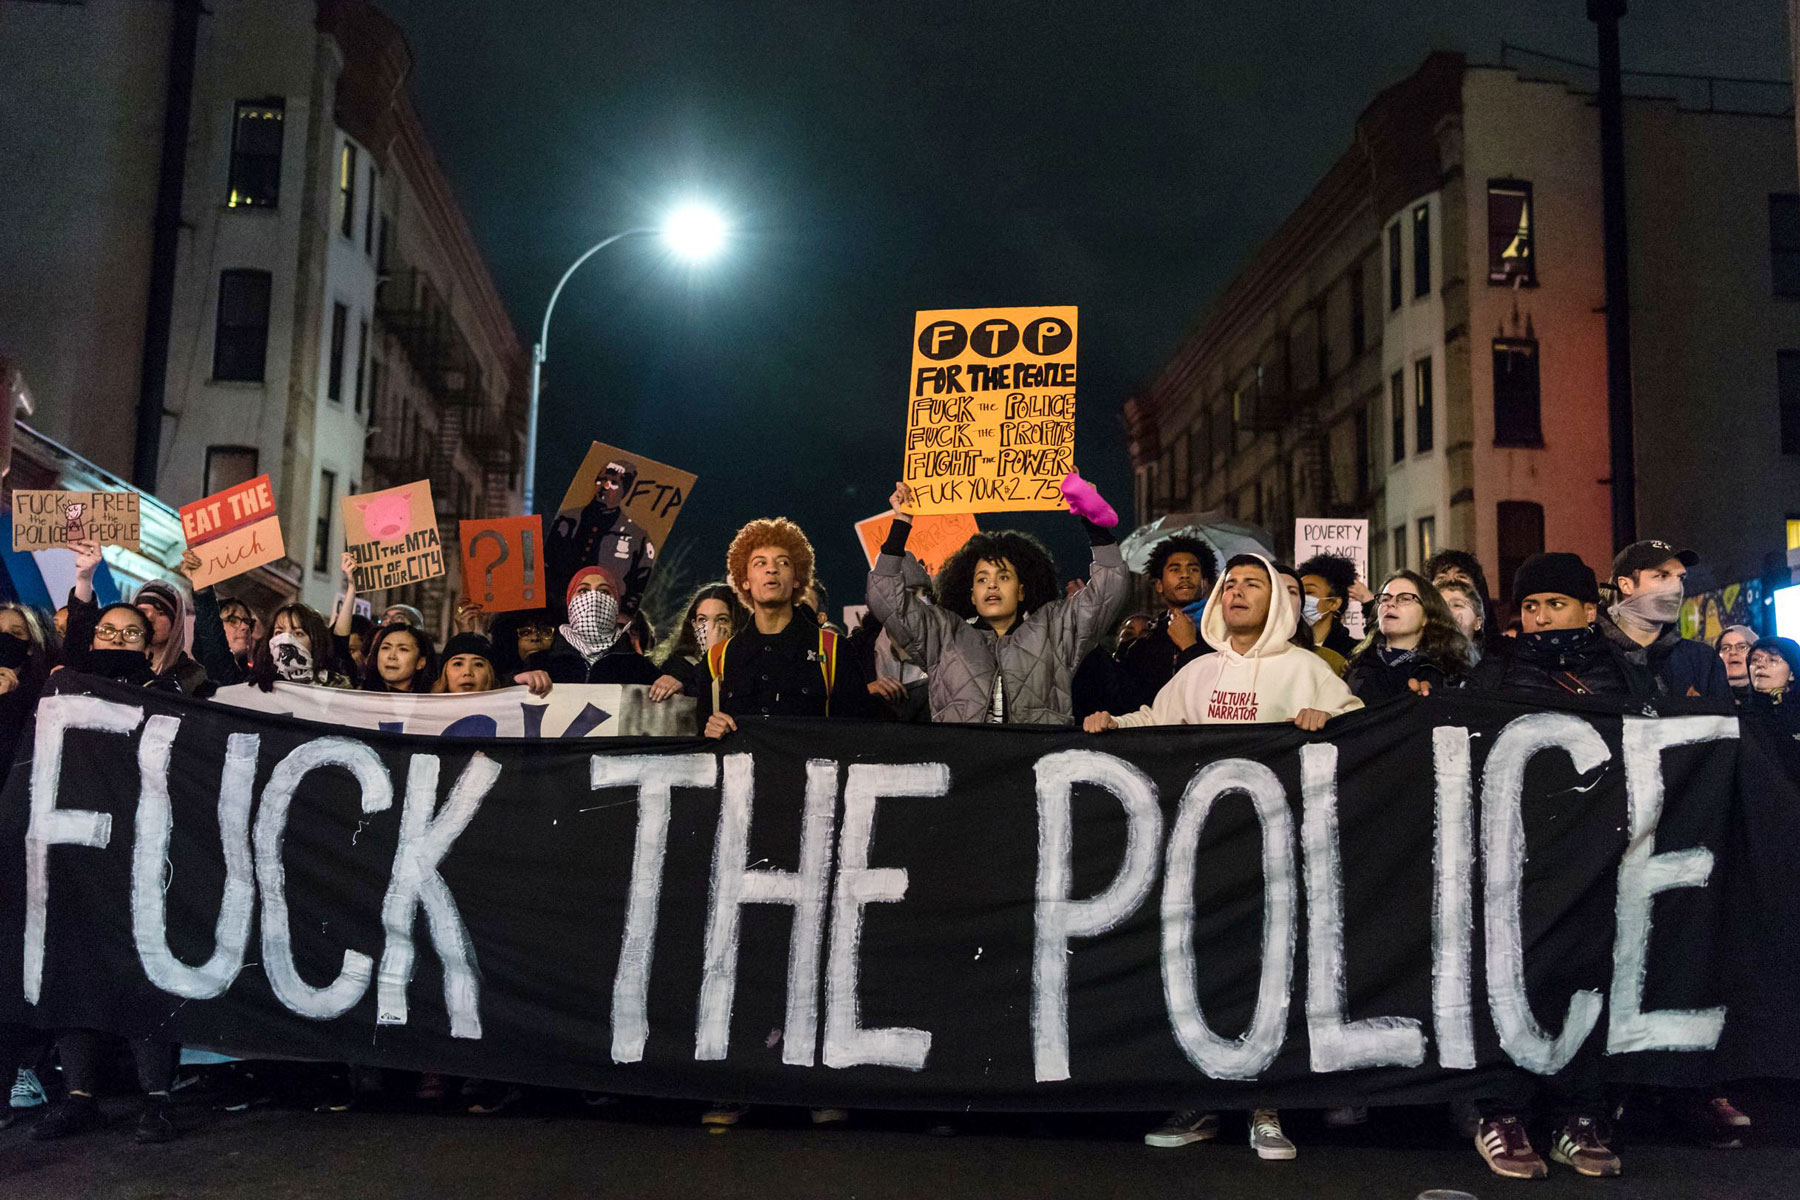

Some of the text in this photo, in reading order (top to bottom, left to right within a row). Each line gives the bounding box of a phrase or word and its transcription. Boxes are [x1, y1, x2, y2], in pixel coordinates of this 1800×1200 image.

[916, 362, 1076, 396] FOR THE PEOPLE
[911, 396, 975, 427] FUCK
[1005, 393, 1076, 420] POLICE
[908, 424, 974, 450] FUCK
[1000, 420, 1075, 447] PROFITS
[907, 449, 983, 480] FIGHT
[997, 446, 1072, 477] POWER
[16, 494, 64, 514] FUCK
[91, 492, 137, 513] FREE
[625, 480, 682, 518] FTP
[914, 478, 965, 508] FUCK
[967, 477, 1005, 503] YOUR
[29, 514, 46, 525] the
[102, 513, 119, 524] the
[183, 483, 272, 540] EAT THE
[14, 523, 67, 546] POLICE
[89, 523, 139, 542] PEOPLE
[381, 543, 406, 558] THE
[405, 528, 440, 552] MTA
[1304, 524, 1362, 541] POVERTY
[208, 530, 265, 576] rich
[1335, 545, 1362, 561] NOT
[352, 550, 443, 591] OUT OF OUR CITY
[1208, 704, 1258, 721] NARRATOR
[1210, 690, 1259, 706] CULTURAL
[23, 694, 1740, 1082] FUCK THE POLICE
